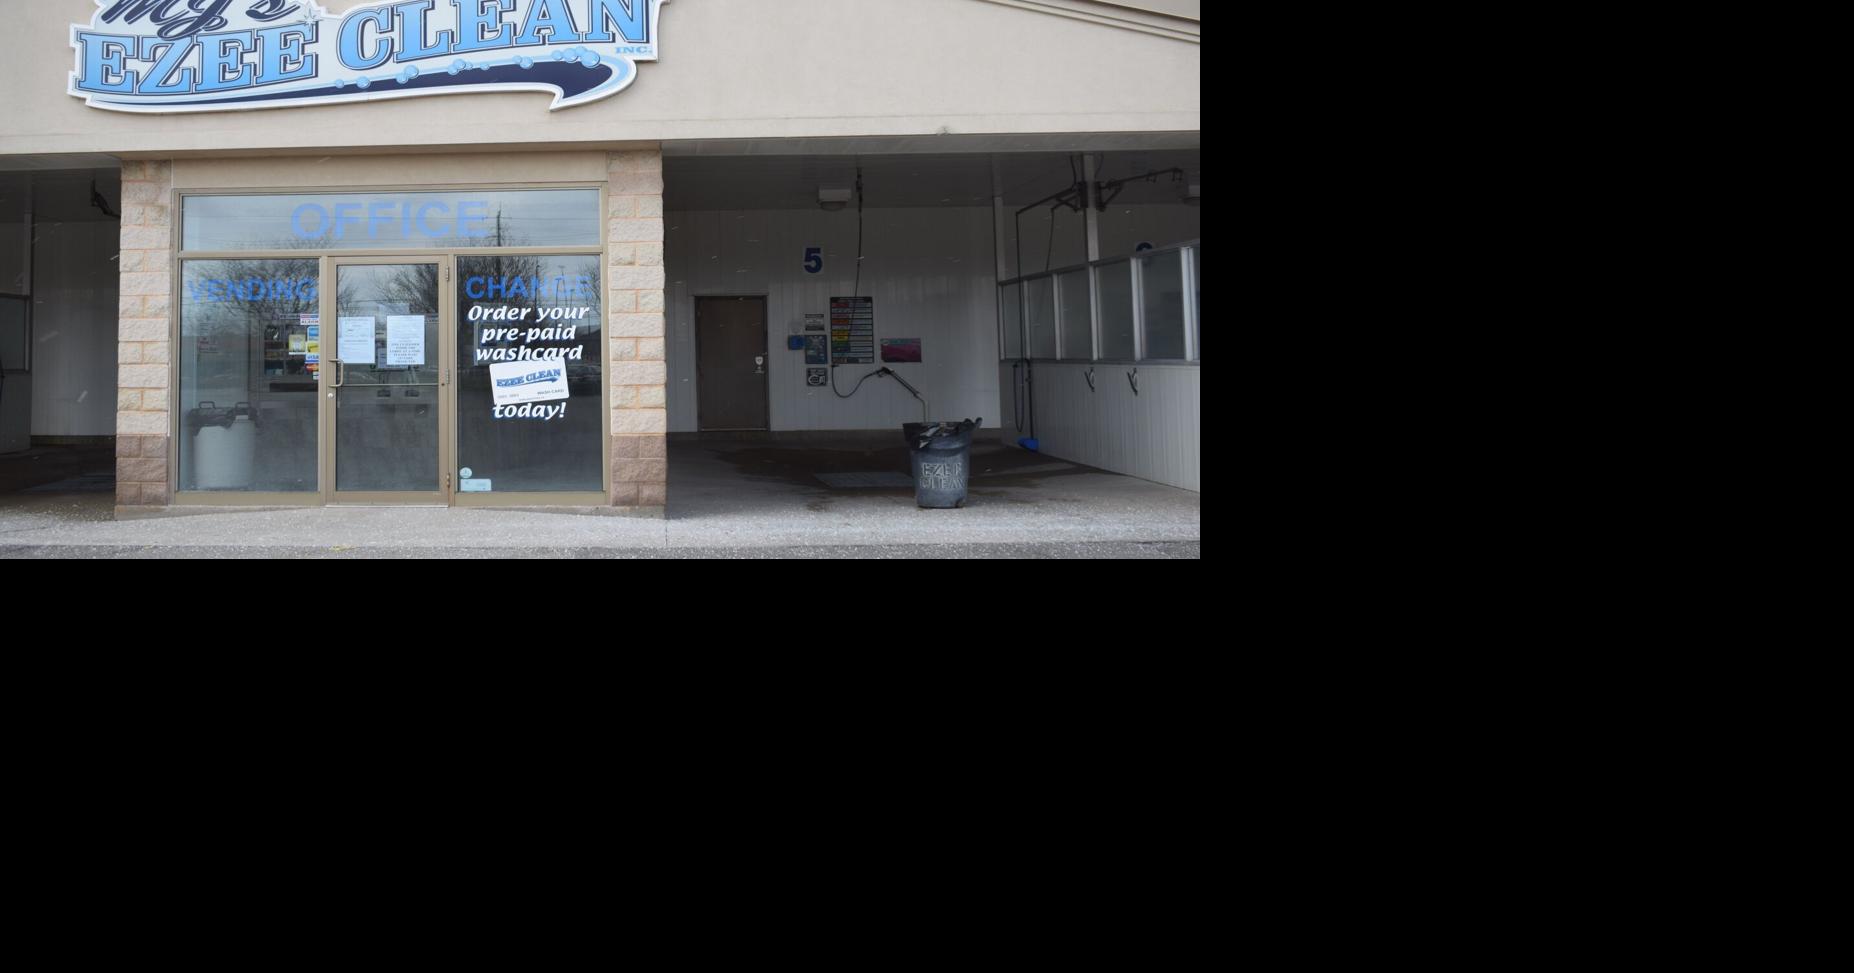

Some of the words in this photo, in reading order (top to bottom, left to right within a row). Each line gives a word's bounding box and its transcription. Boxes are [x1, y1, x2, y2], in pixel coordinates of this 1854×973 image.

[76, 20, 319, 95] EZEE
[336, 0, 651, 70] CLEAN
[615, 46, 653, 55] INC.
[290, 200, 489, 240] OFFICE
[804, 247, 823, 273] 5
[187, 276, 317, 302] VENDING
[465, 275, 592, 299] CHANGE
[468, 305, 531, 320] Order
[536, 307, 589, 322] your
[481, 324, 576, 343] pre-paid
[476, 345, 583, 361] washcard
[526, 368, 561, 381] CLEAN
[493, 402, 567, 420] today!
